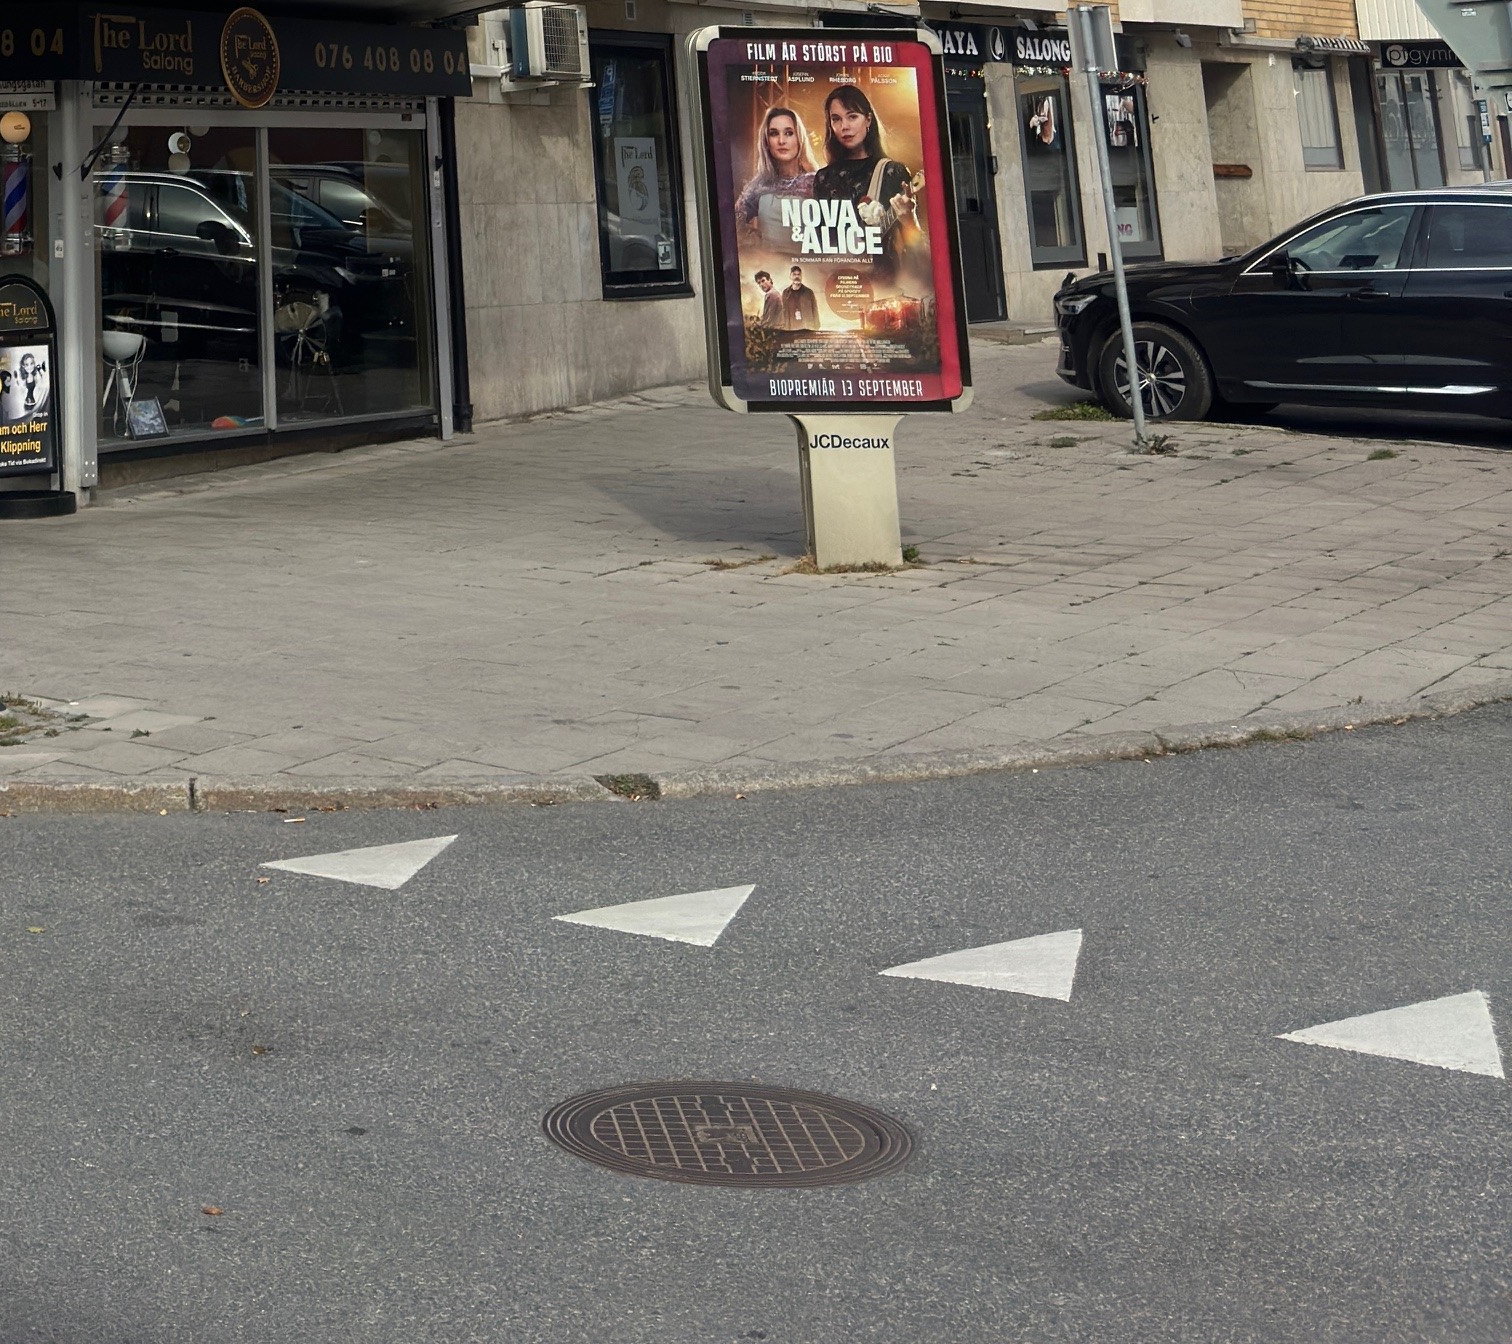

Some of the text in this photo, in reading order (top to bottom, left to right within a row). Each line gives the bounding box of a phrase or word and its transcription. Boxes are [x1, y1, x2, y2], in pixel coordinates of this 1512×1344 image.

[30, 28, 64, 56] 04
[89, 12, 192, 74] The Lord
[747, 42, 893, 63] FILM ÄR STÖRST PÅ BIO
[1016, 36, 1071, 62] SALONG
[143, 51, 194, 75] Salong
[315, 42, 466, 75] 076 408 08 04
[781, 198, 859, 228] NOVA
[14, 301, 38, 315] Lord
[769, 378, 923, 397] BIOPREMIÄR 13 SEPTEMBER
[12, 422, 27, 435] och
[29, 420, 48, 433] Herr
[0, 439, 41, 455] Klippning
[809, 434, 890, 449] JCDecaux
